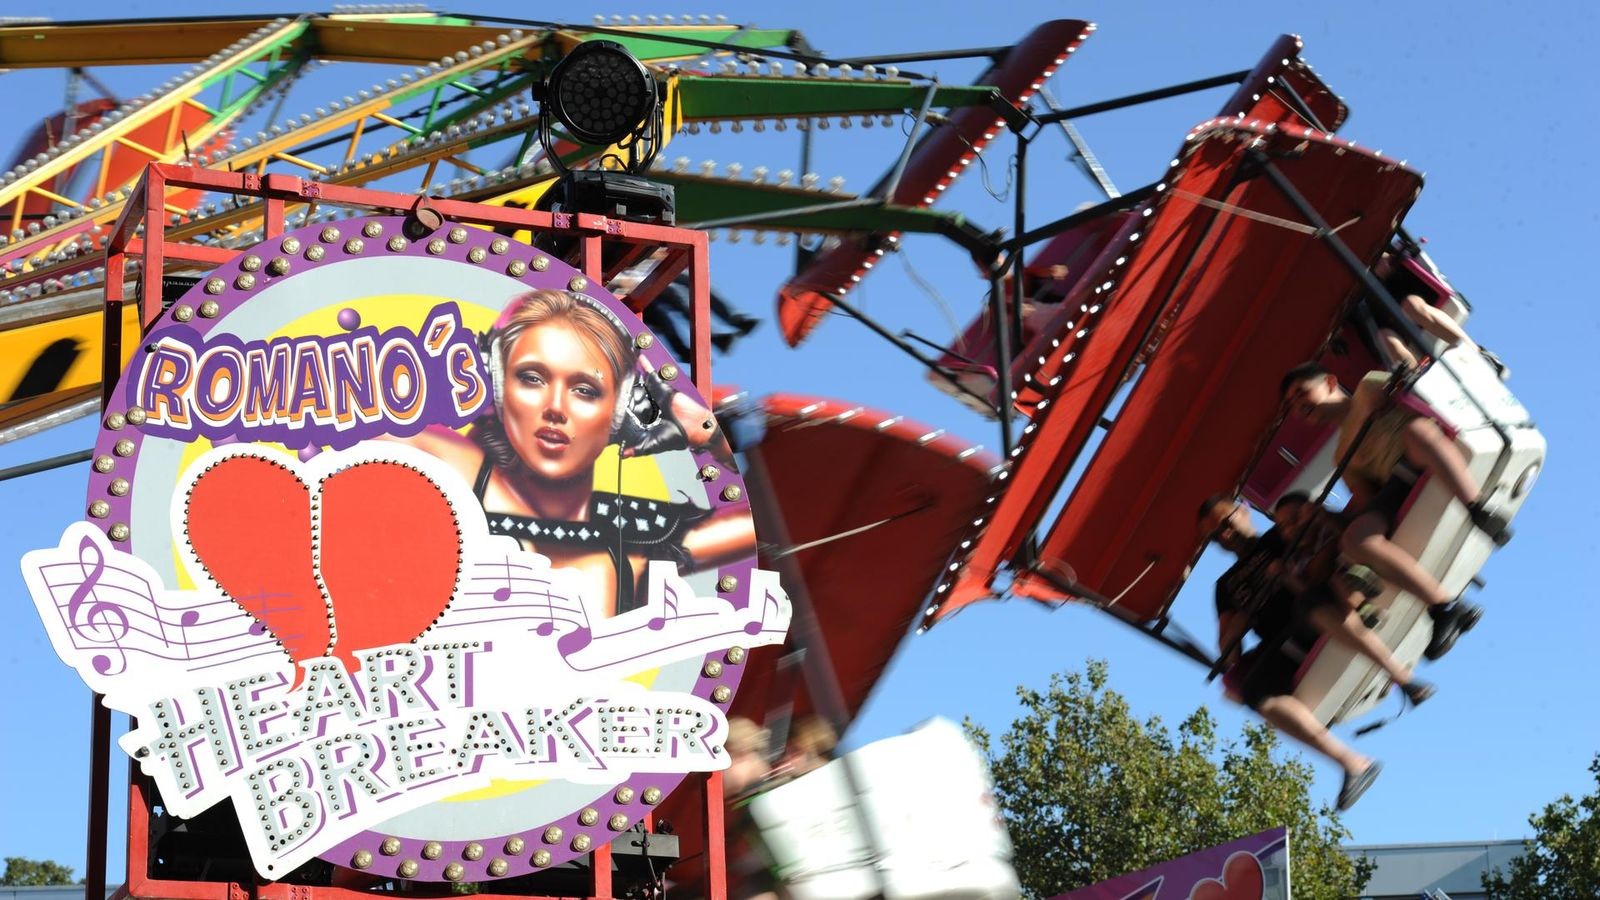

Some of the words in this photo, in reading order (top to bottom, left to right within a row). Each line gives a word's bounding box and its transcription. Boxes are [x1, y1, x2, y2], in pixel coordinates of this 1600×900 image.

[139, 315, 486, 429] ROMANO'S
[149, 640, 493, 800] HEART
[243, 697, 719, 857] BREAKER
